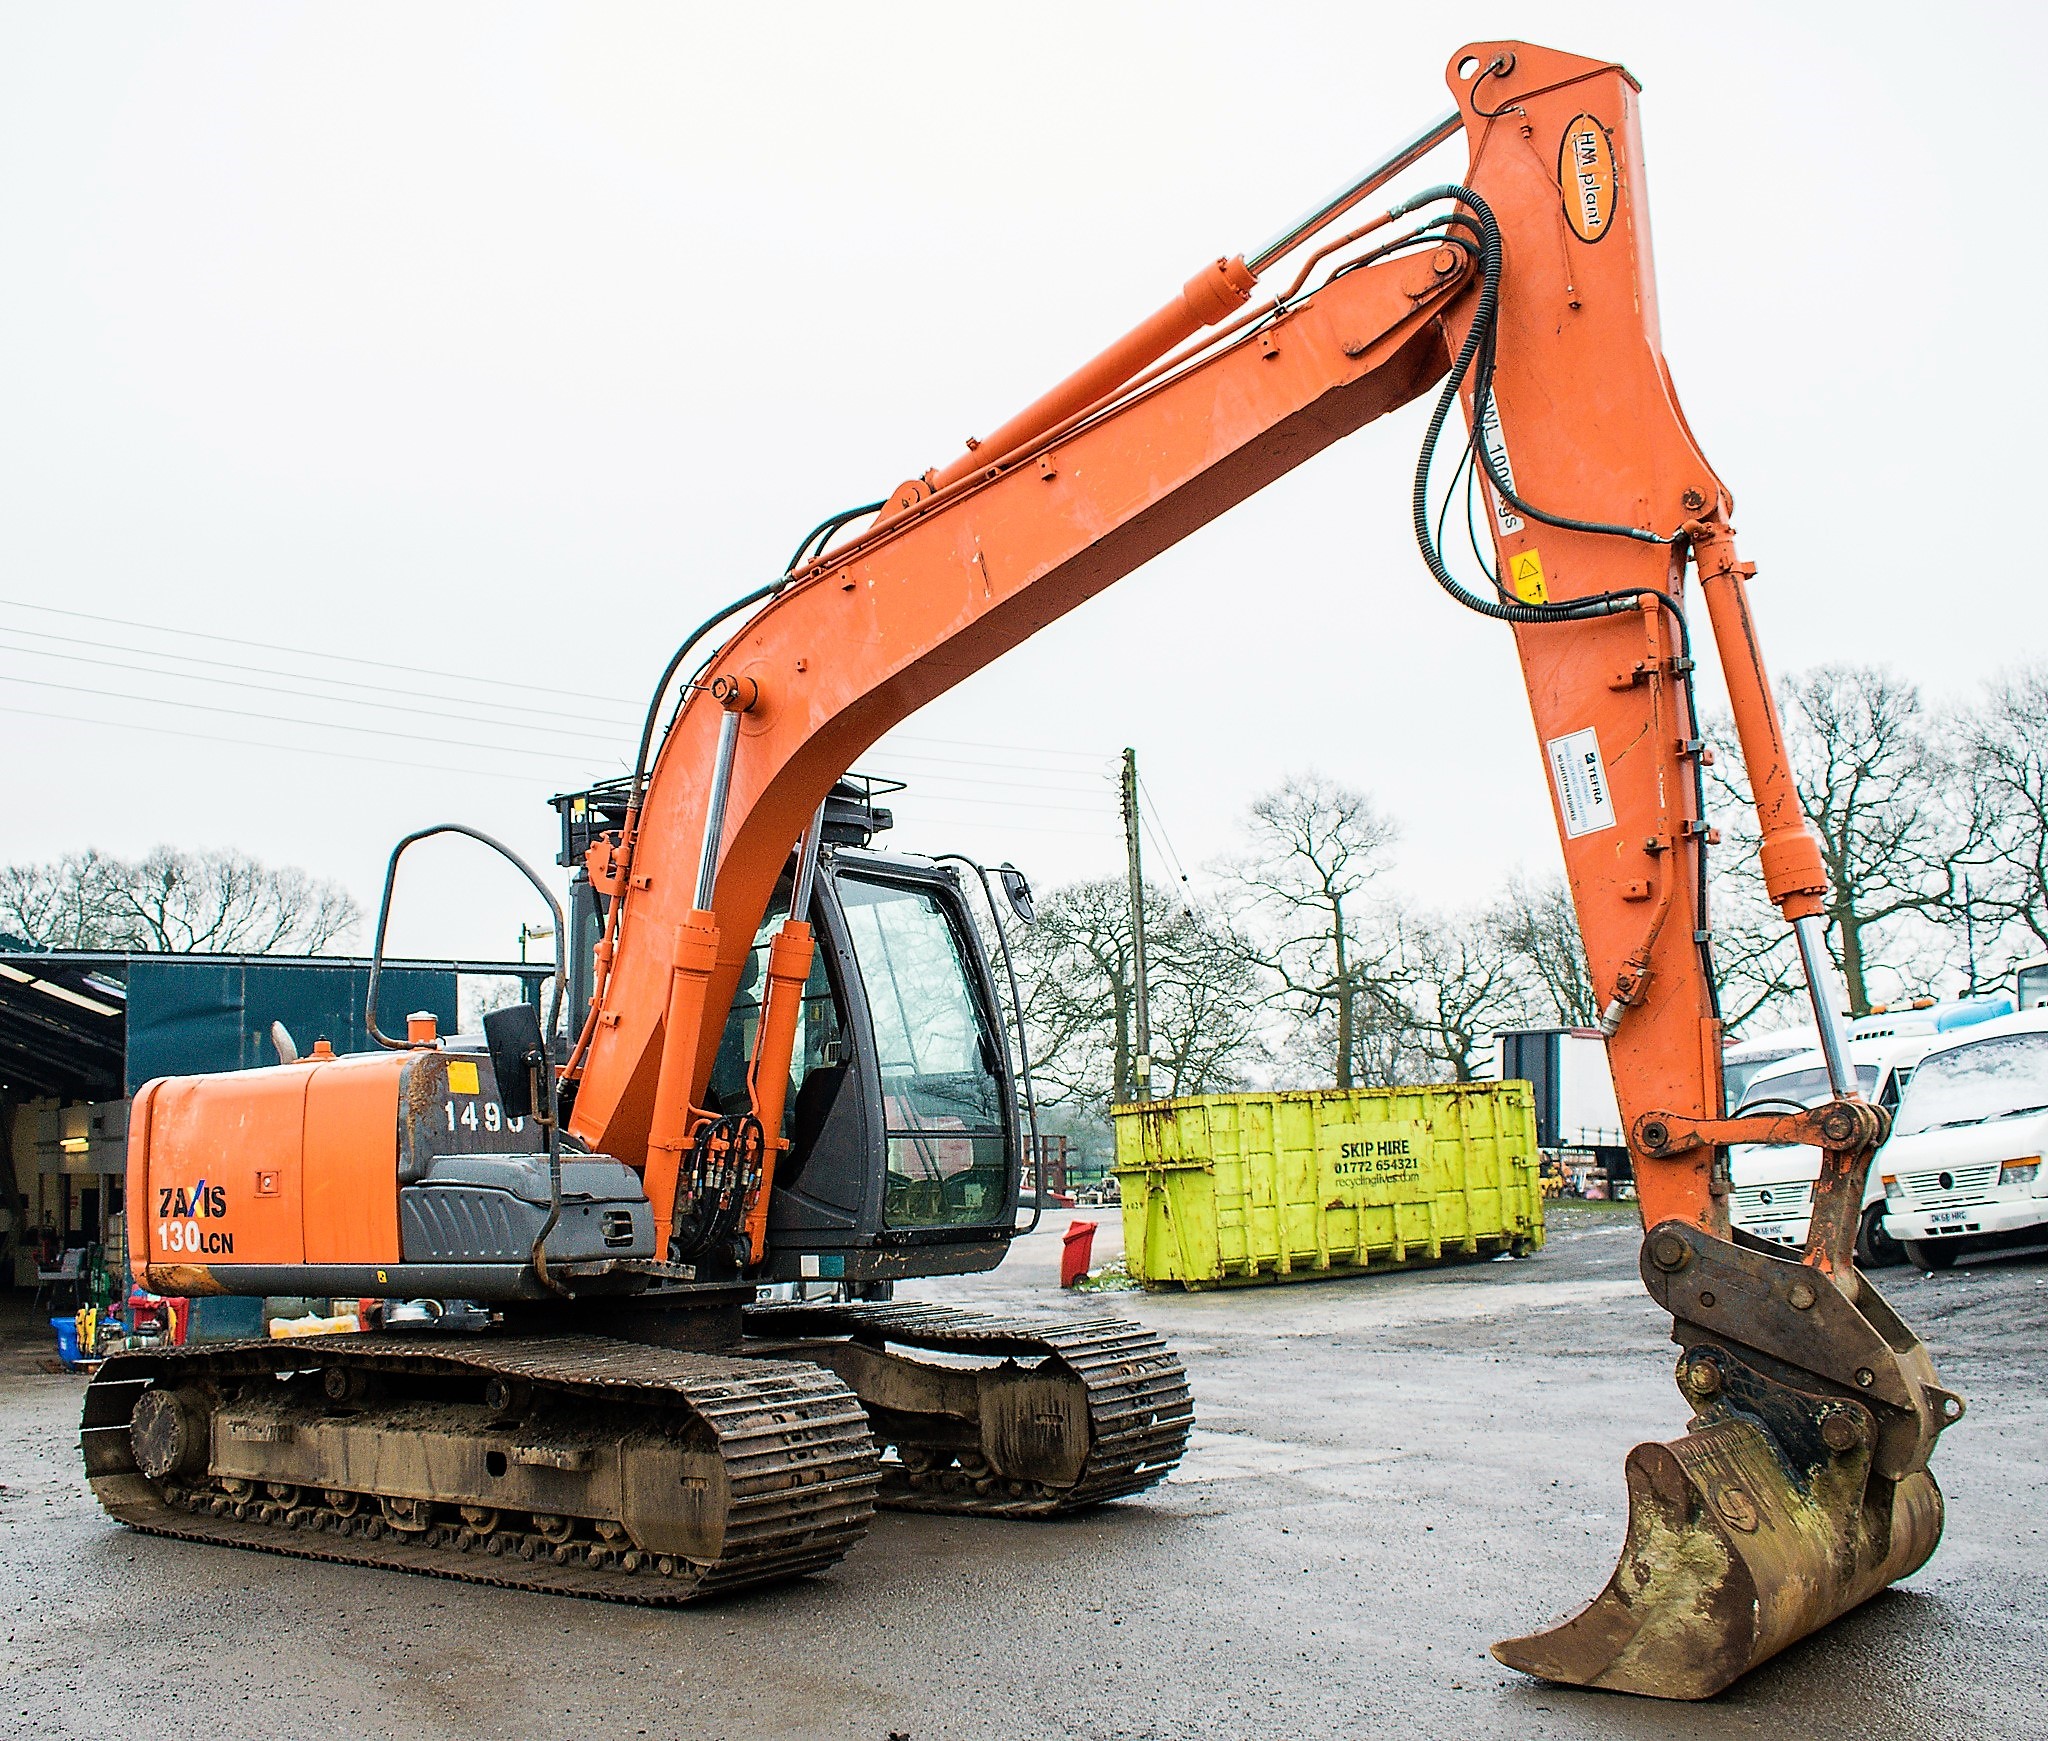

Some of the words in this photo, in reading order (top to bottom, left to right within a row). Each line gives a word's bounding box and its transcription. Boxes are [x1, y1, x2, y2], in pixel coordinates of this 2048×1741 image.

[1580, 132, 1597, 166] HM
[1578, 173, 1601, 226] plant
[1588, 766, 1603, 805] TEFRA
[1335, 1161, 1372, 1174] 01772
[1376, 1158, 1418, 1171] 654321
[1341, 1142, 1374, 1158] SKIP
[1377, 1140, 1410, 1156] HIRE
[159, 1180, 227, 1218] ZAXIS
